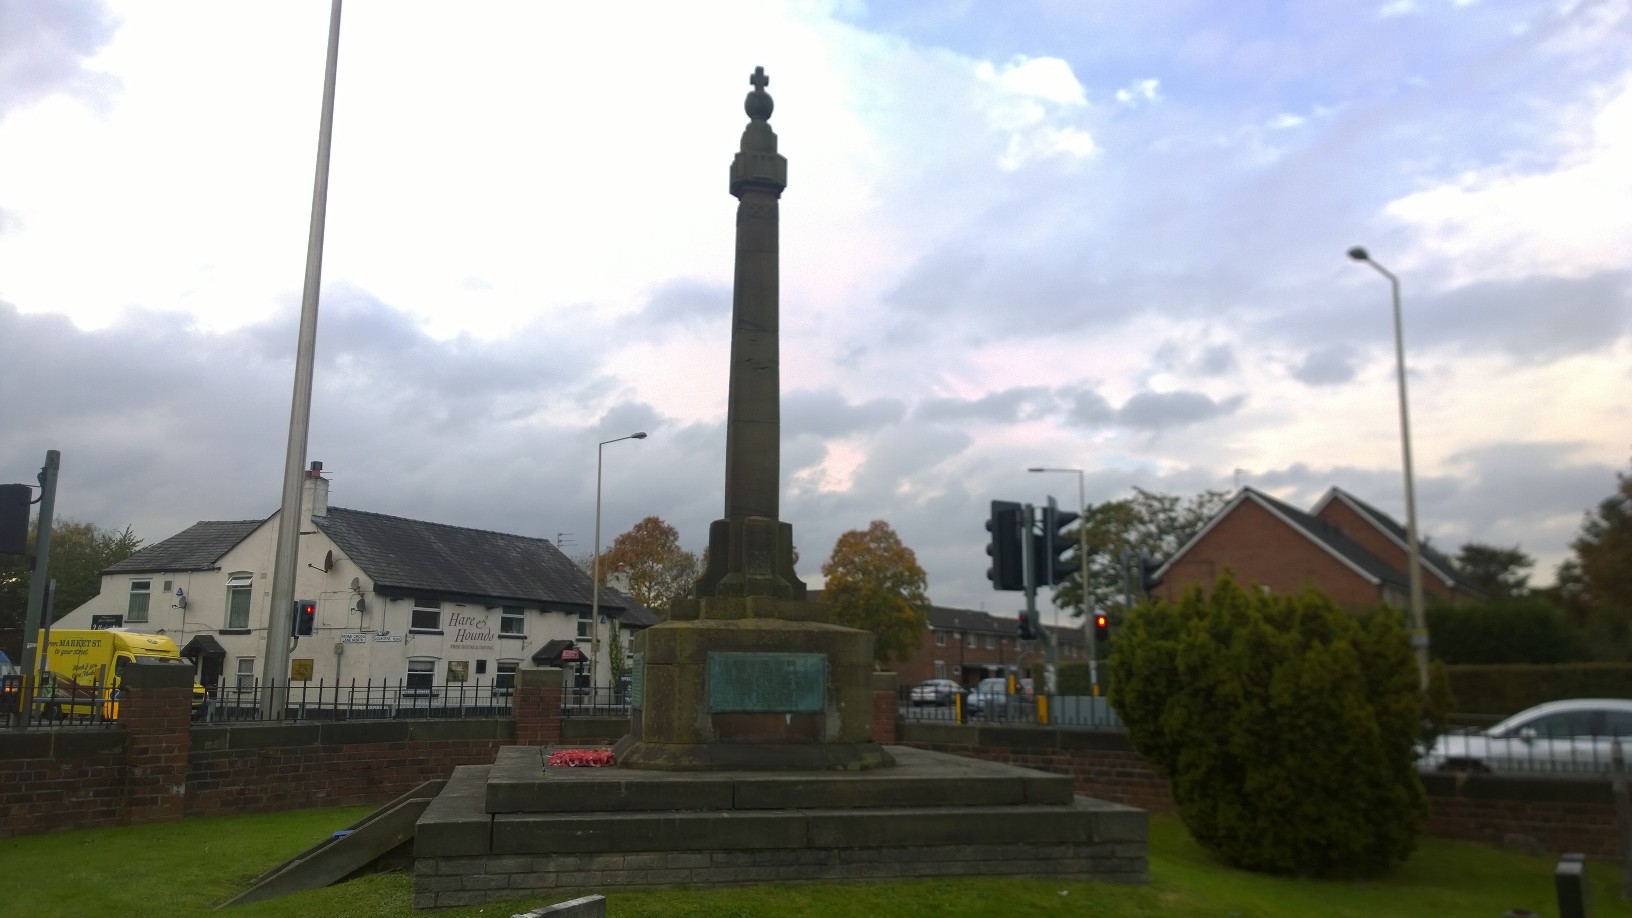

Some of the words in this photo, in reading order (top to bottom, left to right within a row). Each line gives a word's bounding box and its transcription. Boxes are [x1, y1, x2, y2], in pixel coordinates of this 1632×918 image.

[448, 612, 476, 627] Hare
[475, 614, 489, 630] &
[454, 627, 494, 643] Hounds
[59, 639, 92, 647] MARKET
[91, 639, 102, 648] ST.
